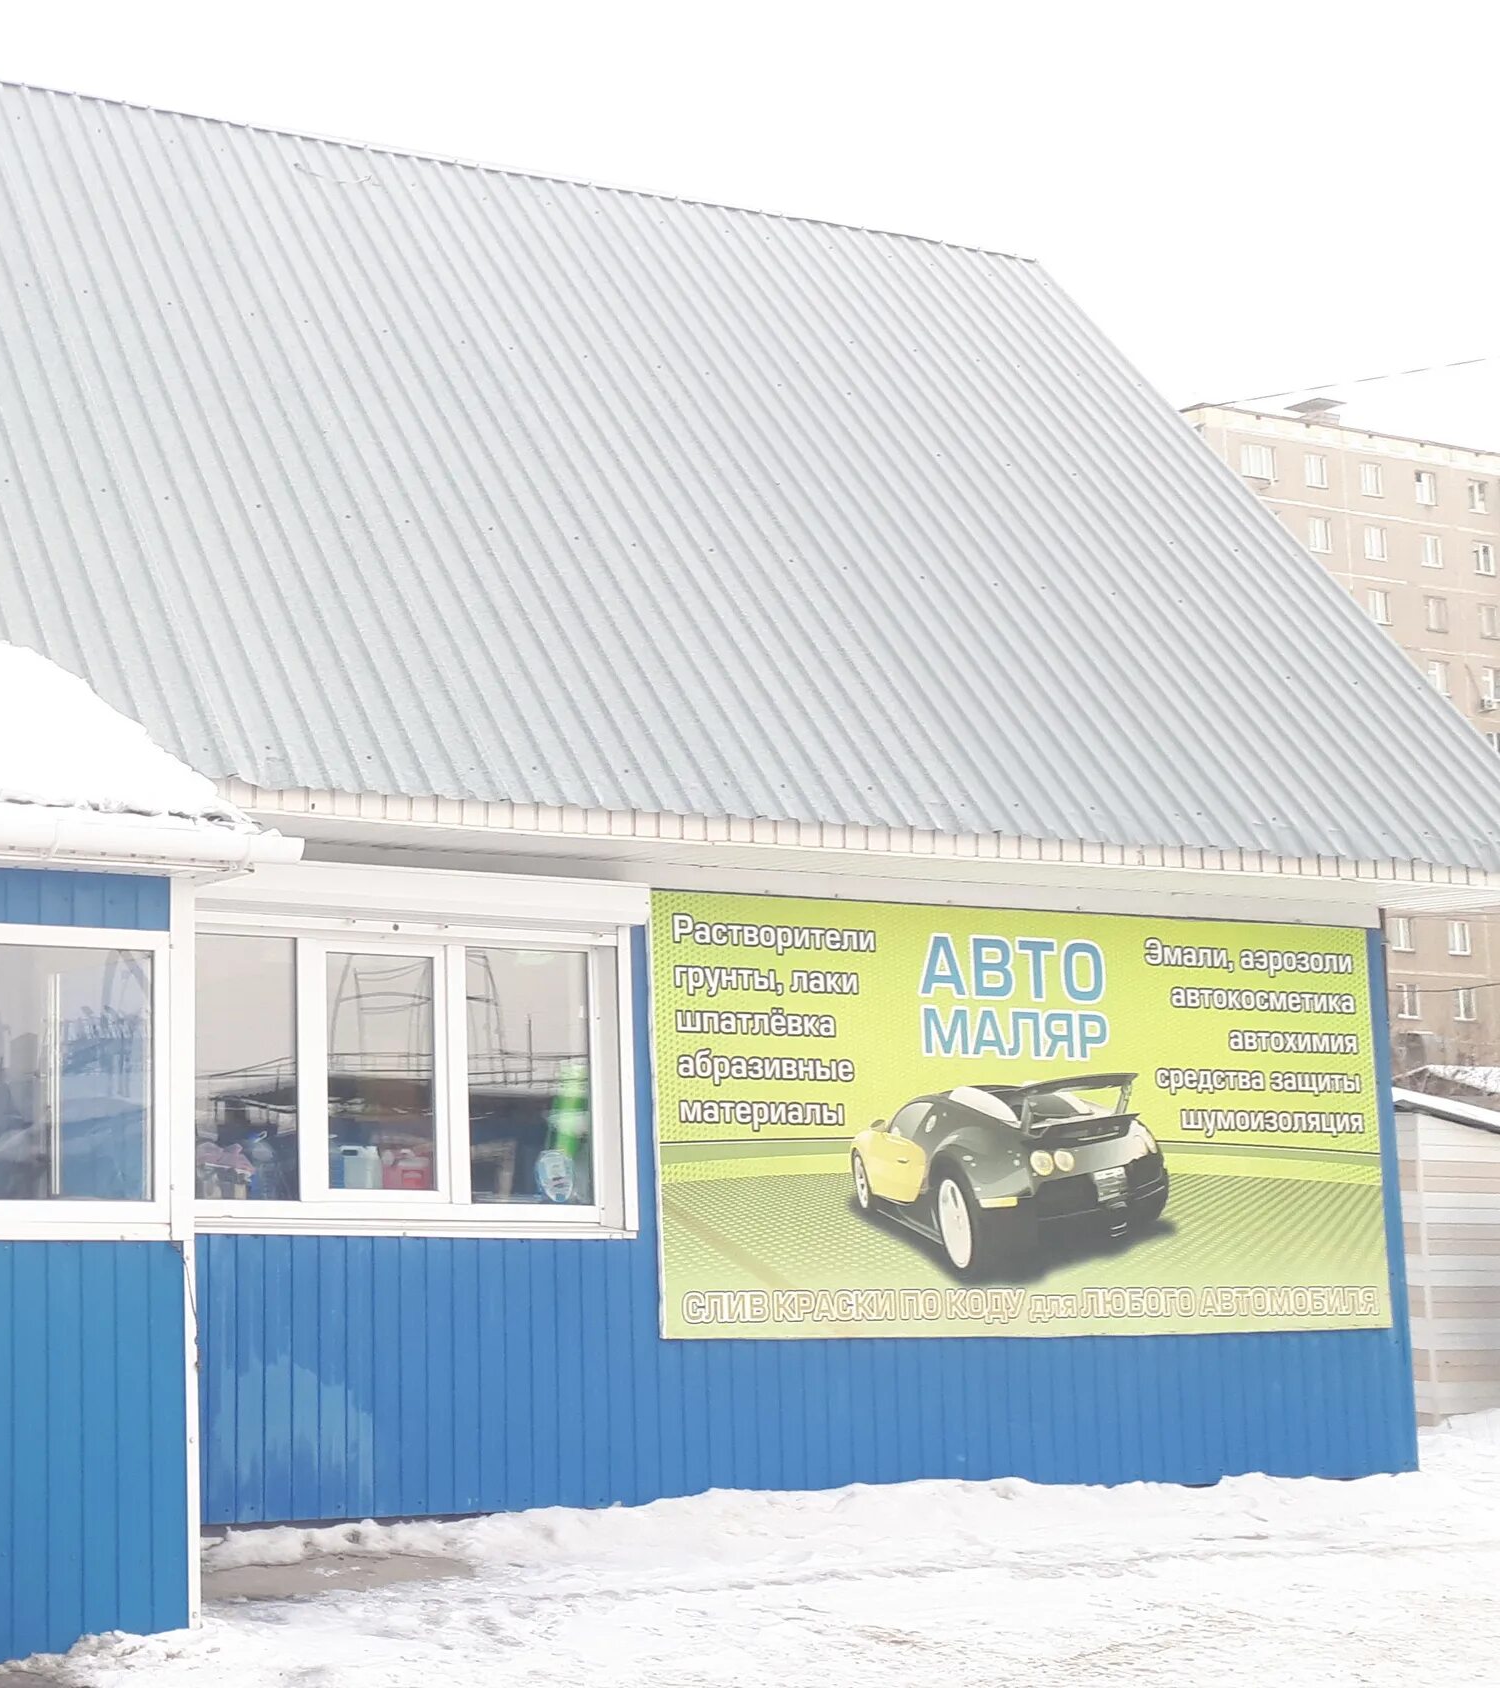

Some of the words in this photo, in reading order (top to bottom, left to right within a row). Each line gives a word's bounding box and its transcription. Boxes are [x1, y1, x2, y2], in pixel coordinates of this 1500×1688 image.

[671, 912, 876, 955] Растворители
[918, 933, 1106, 1004] АВТО
[1143, 936, 1235, 972] Эмали,
[1240, 949, 1353, 977] аэрозоли
[673, 965, 784, 997] грунты,
[790, 970, 859, 995] лаки
[1171, 984, 1356, 1015] автокосметика
[675, 1008, 836, 1038] шпатлёвка
[920, 1004, 1109, 1062] МАЛЯР
[1228, 1029, 1358, 1055] автохимия
[677, 1048, 855, 1086] абразивные
[1155, 1067, 1265, 1095] средства
[1270, 1071, 1361, 1096] защиты
[679, 1099, 845, 1131] материалы
[1180, 1107, 1364, 1137] шумоизоляция
[682, 1289, 770, 1324] СЛИВ
[773, 1288, 896, 1323] КРАСКИ
[900, 1288, 941, 1321] ПО
[946, 1287, 1025, 1324] КОДУ
[1028, 1294, 1077, 1323] для
[1079, 1286, 1196, 1318] ЛЮБОГО
[1198, 1285, 1380, 1318] АВТОМОБИЛЯ
